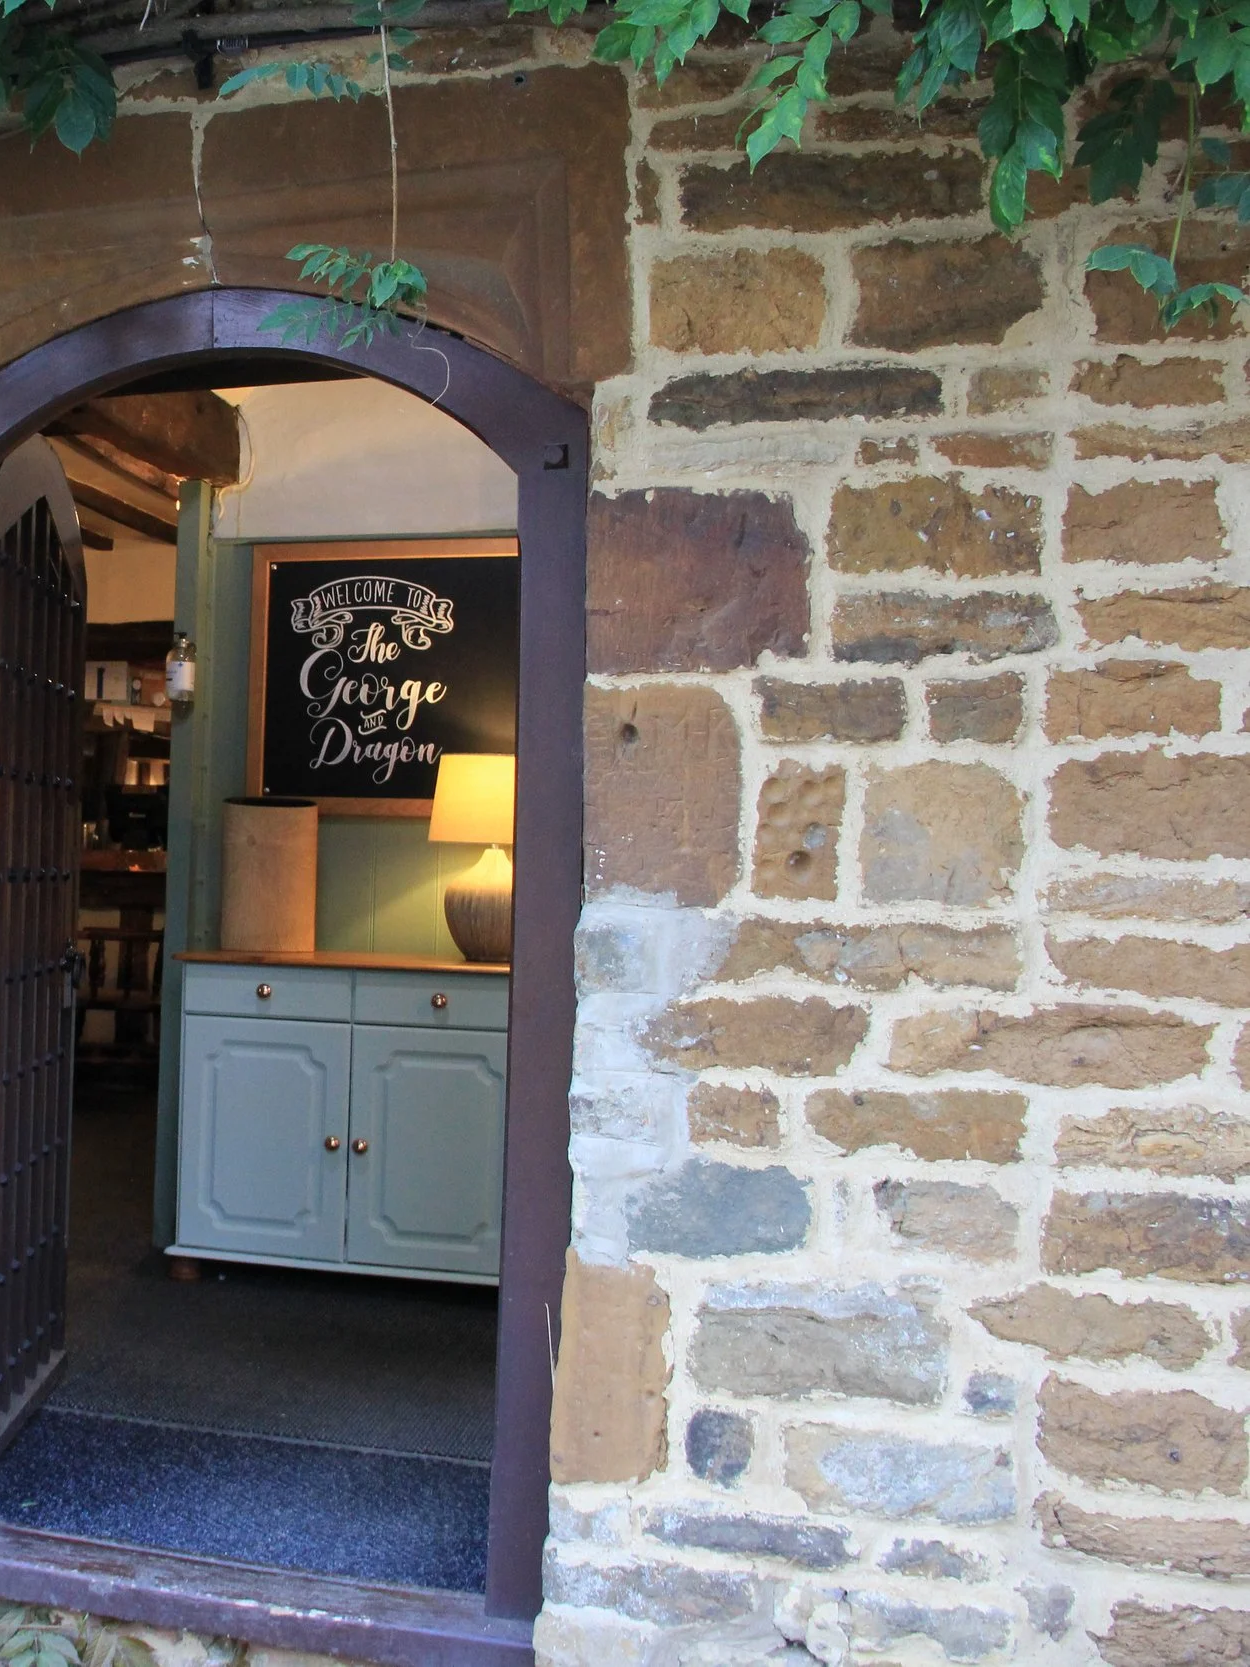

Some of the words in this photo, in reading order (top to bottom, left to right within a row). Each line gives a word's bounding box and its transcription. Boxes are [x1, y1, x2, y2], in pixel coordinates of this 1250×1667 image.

[320, 580, 396, 609] WELCOME
[406, 586, 423, 608] TO
[347, 622, 401, 663] The
[300, 649, 447, 731] George
[363, 715, 385, 729] AND
[309, 717, 443, 784] Dragon
